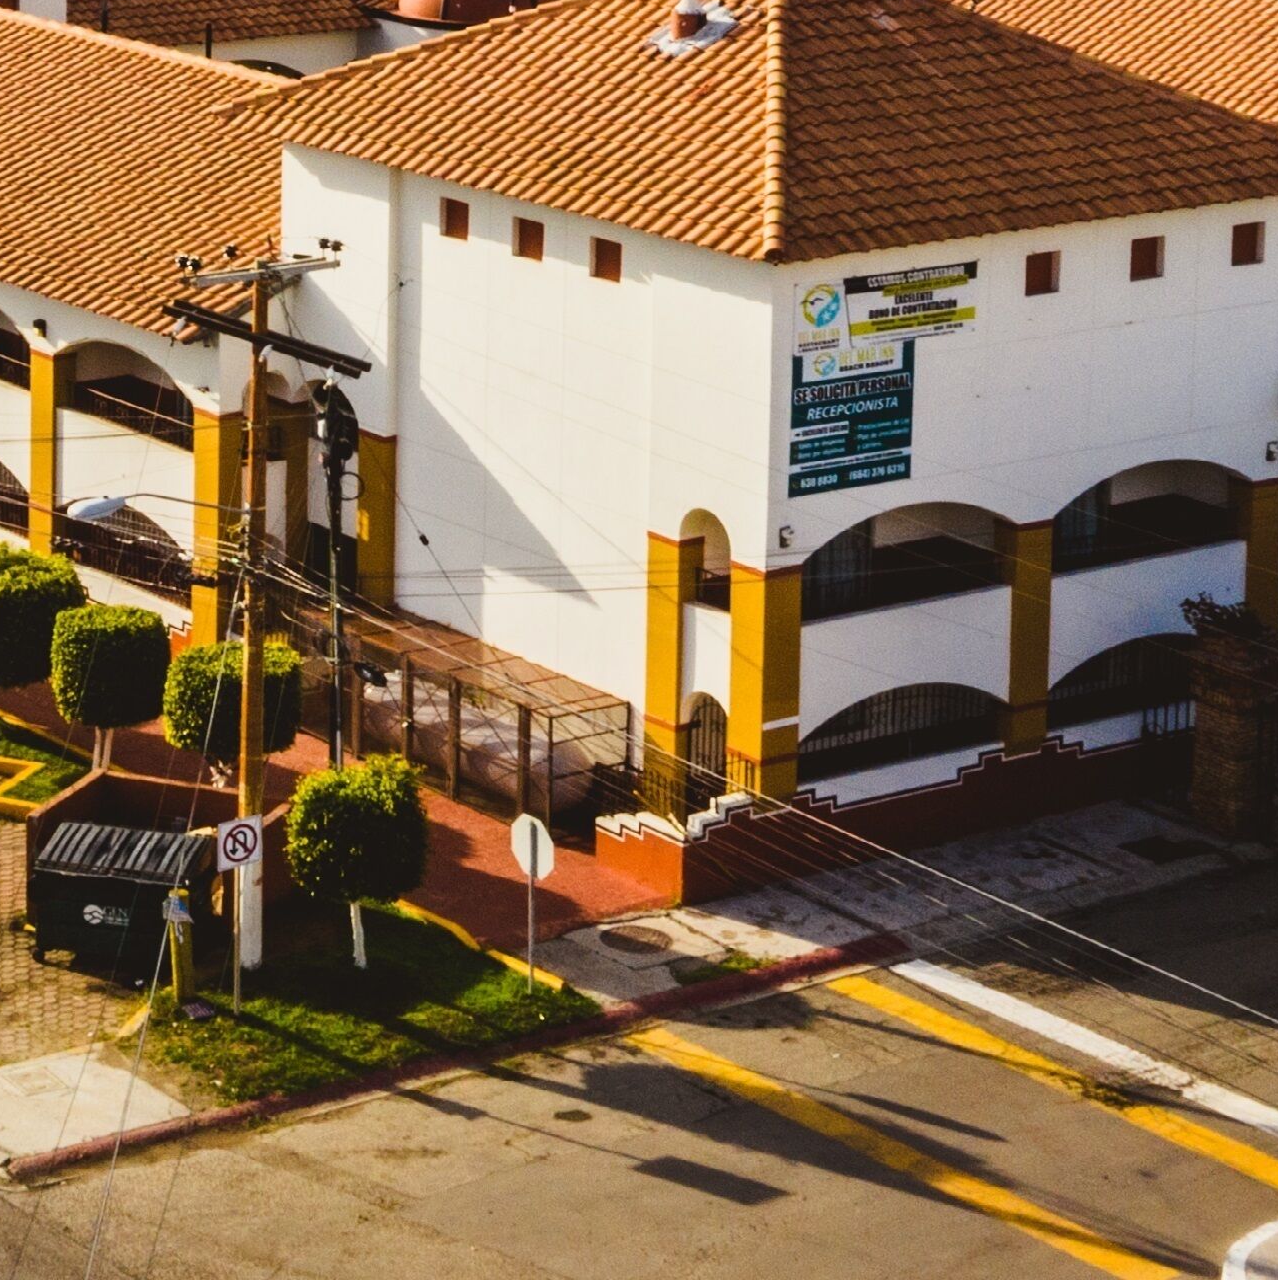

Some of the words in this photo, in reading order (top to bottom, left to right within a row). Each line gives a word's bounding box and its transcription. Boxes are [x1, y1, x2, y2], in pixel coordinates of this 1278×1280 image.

[794, 388, 810, 405] SE
[810, 381, 857, 402] SOLICITA
[857, 372, 911, 396] PERSONAL
[806, 396, 899, 420] RECEPCIONISTA
